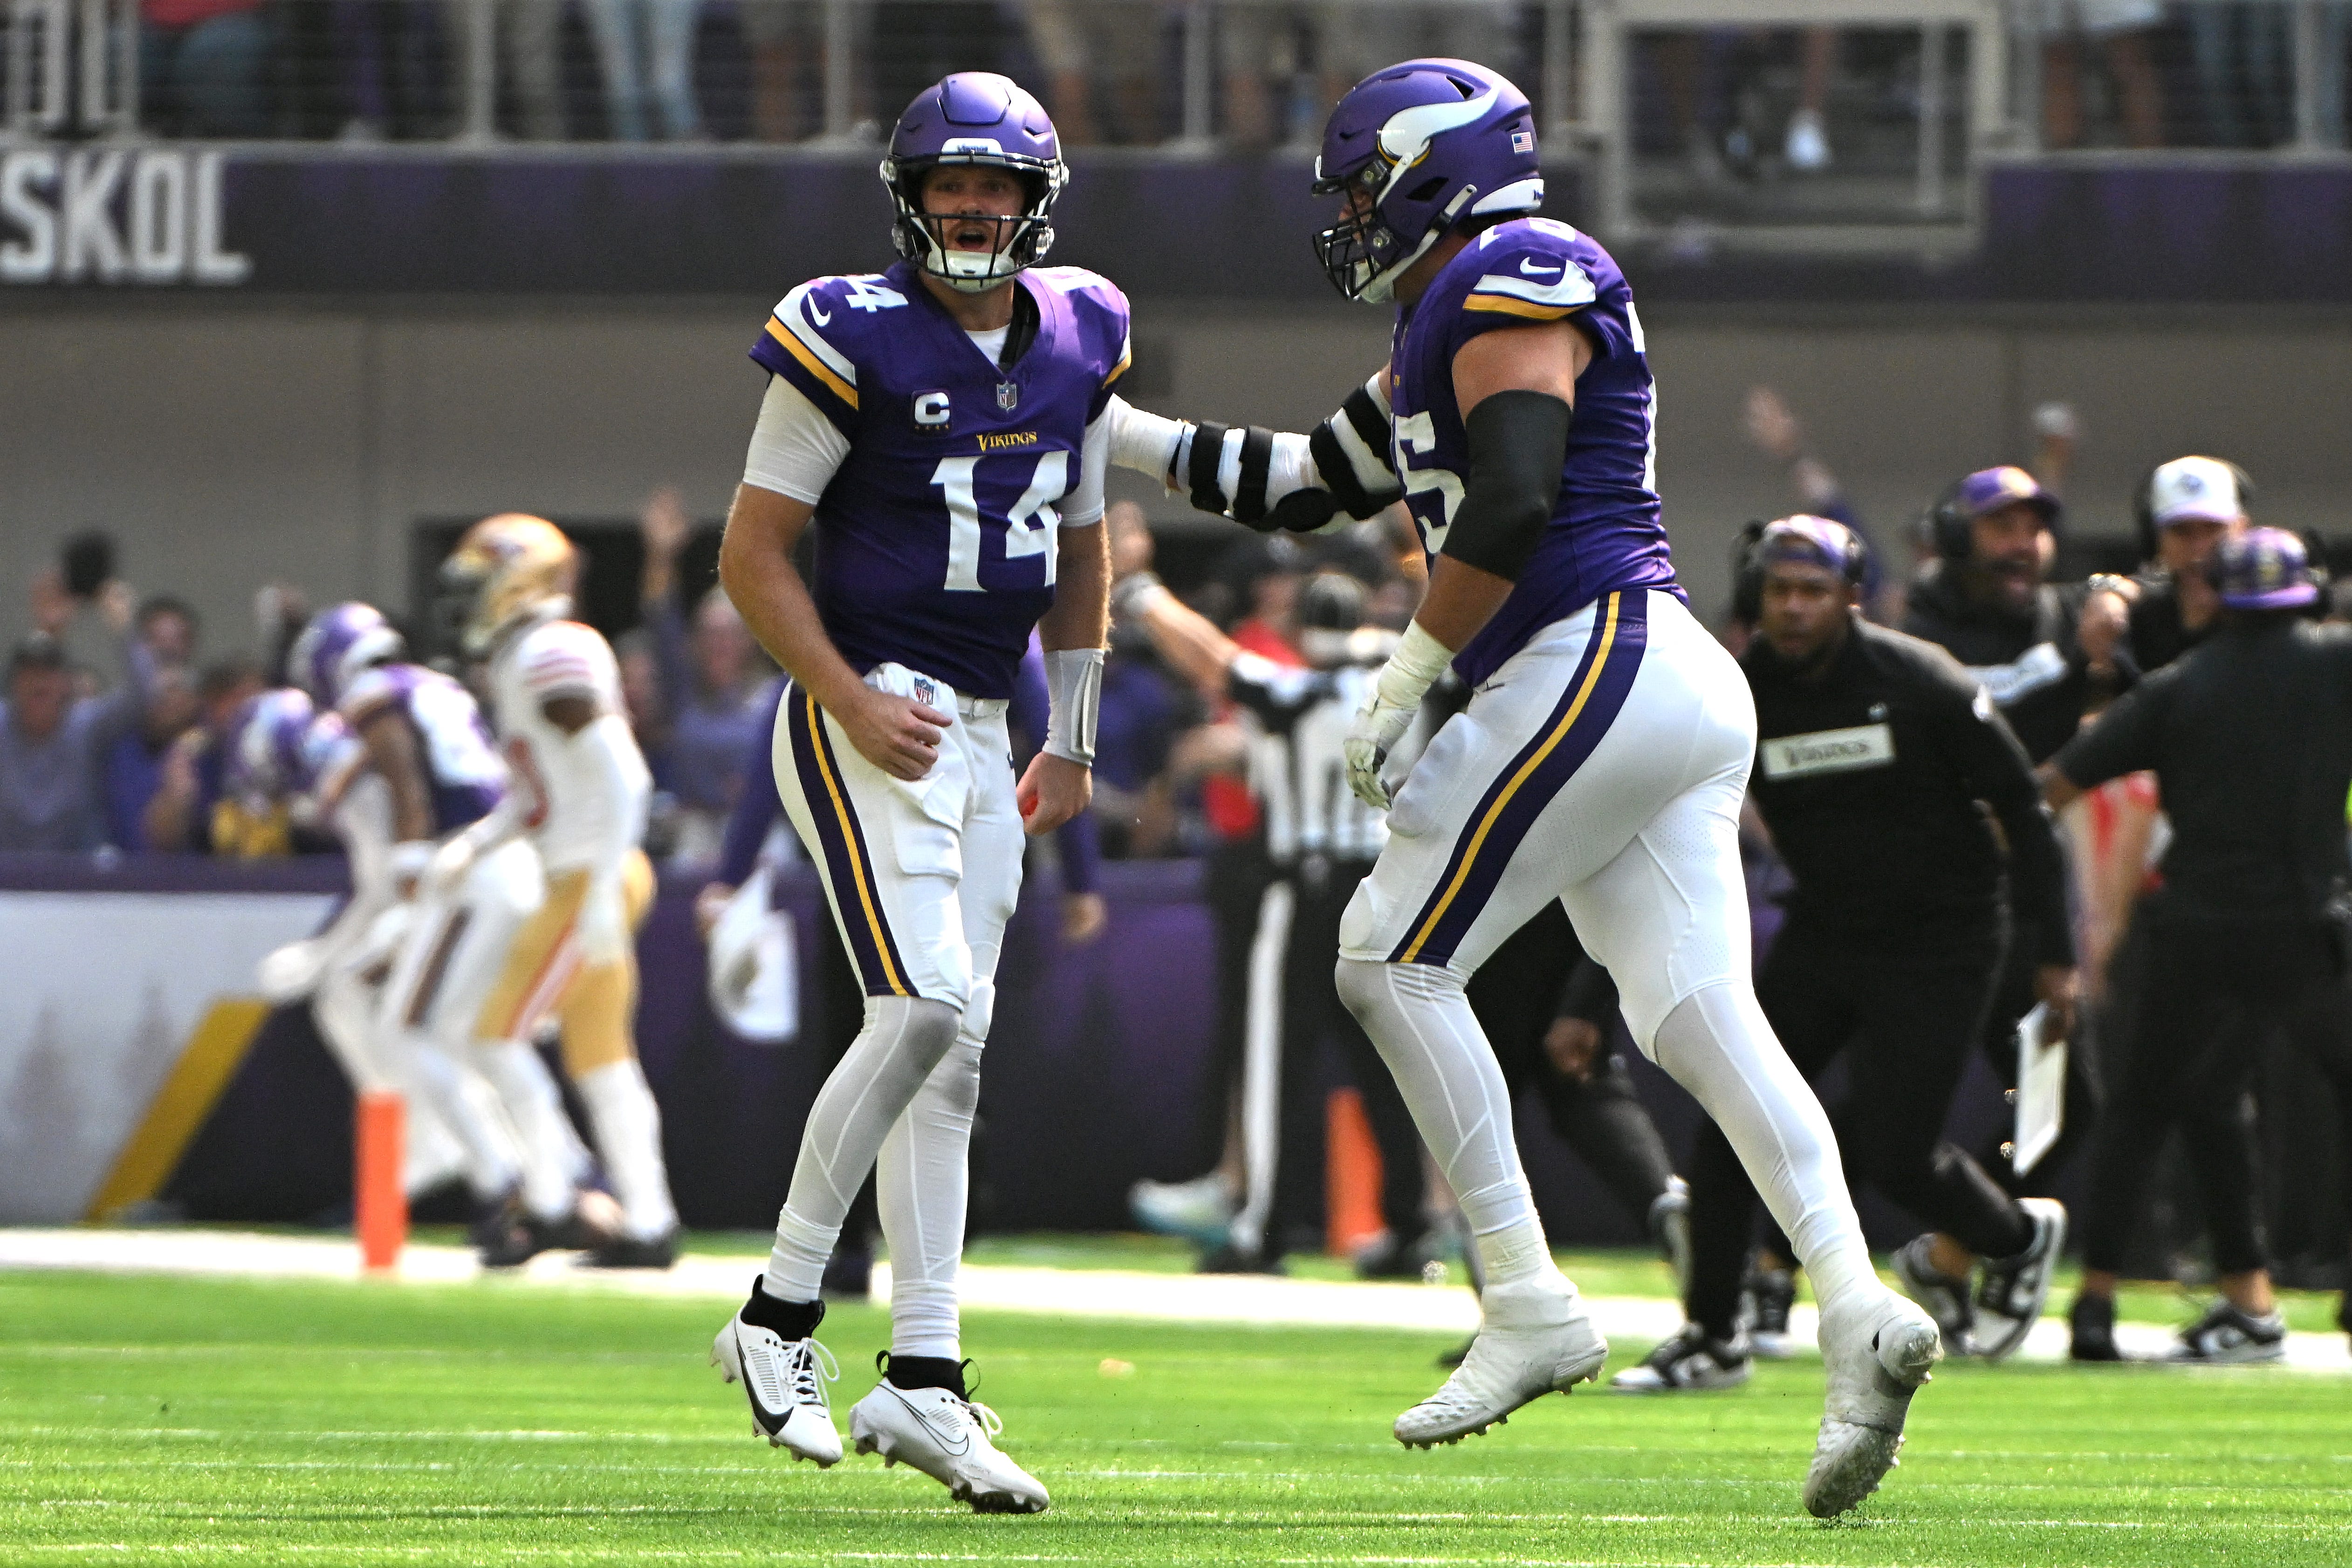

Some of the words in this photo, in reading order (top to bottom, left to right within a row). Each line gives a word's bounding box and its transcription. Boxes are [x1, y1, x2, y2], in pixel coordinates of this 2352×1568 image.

[0, 150, 254, 282] SKOL
[914, 392, 951, 424] C
[929, 450, 1070, 593] 14
[1390, 411, 1466, 555] 5
